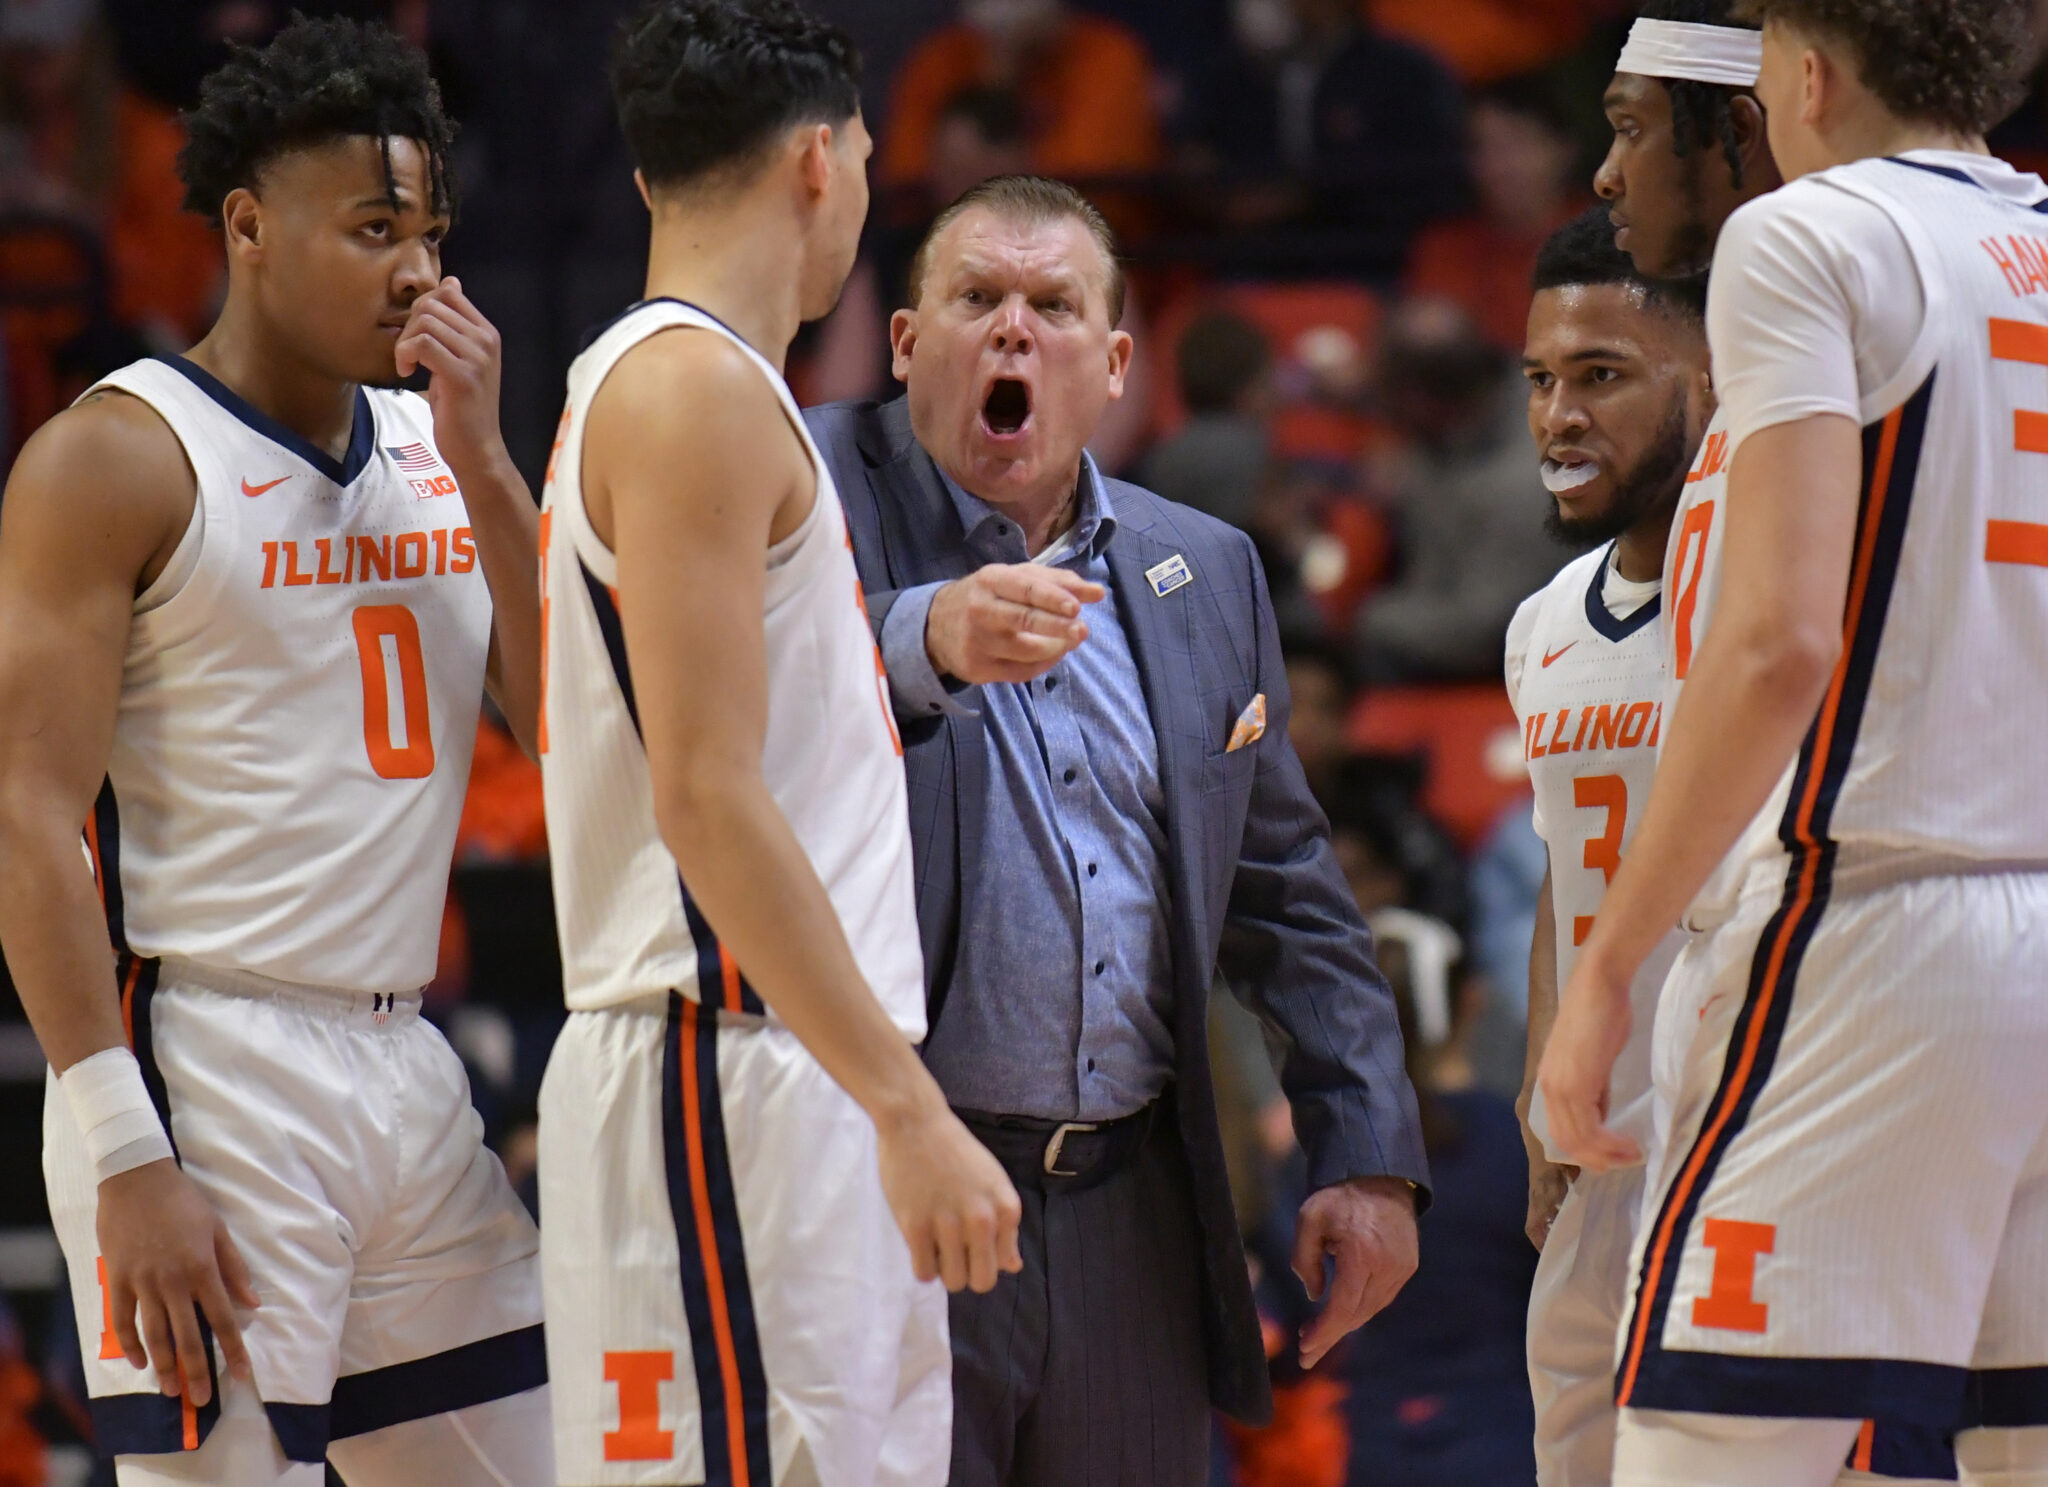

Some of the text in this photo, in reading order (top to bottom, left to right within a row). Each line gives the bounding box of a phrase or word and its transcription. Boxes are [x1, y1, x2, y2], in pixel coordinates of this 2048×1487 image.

[1980, 234, 2048, 298] HA
[261, 527, 476, 588] ILLINOIS
[352, 604, 435, 780] 0
[1525, 701, 1663, 762] ILLINOI
[1573, 774, 1628, 946] 3
